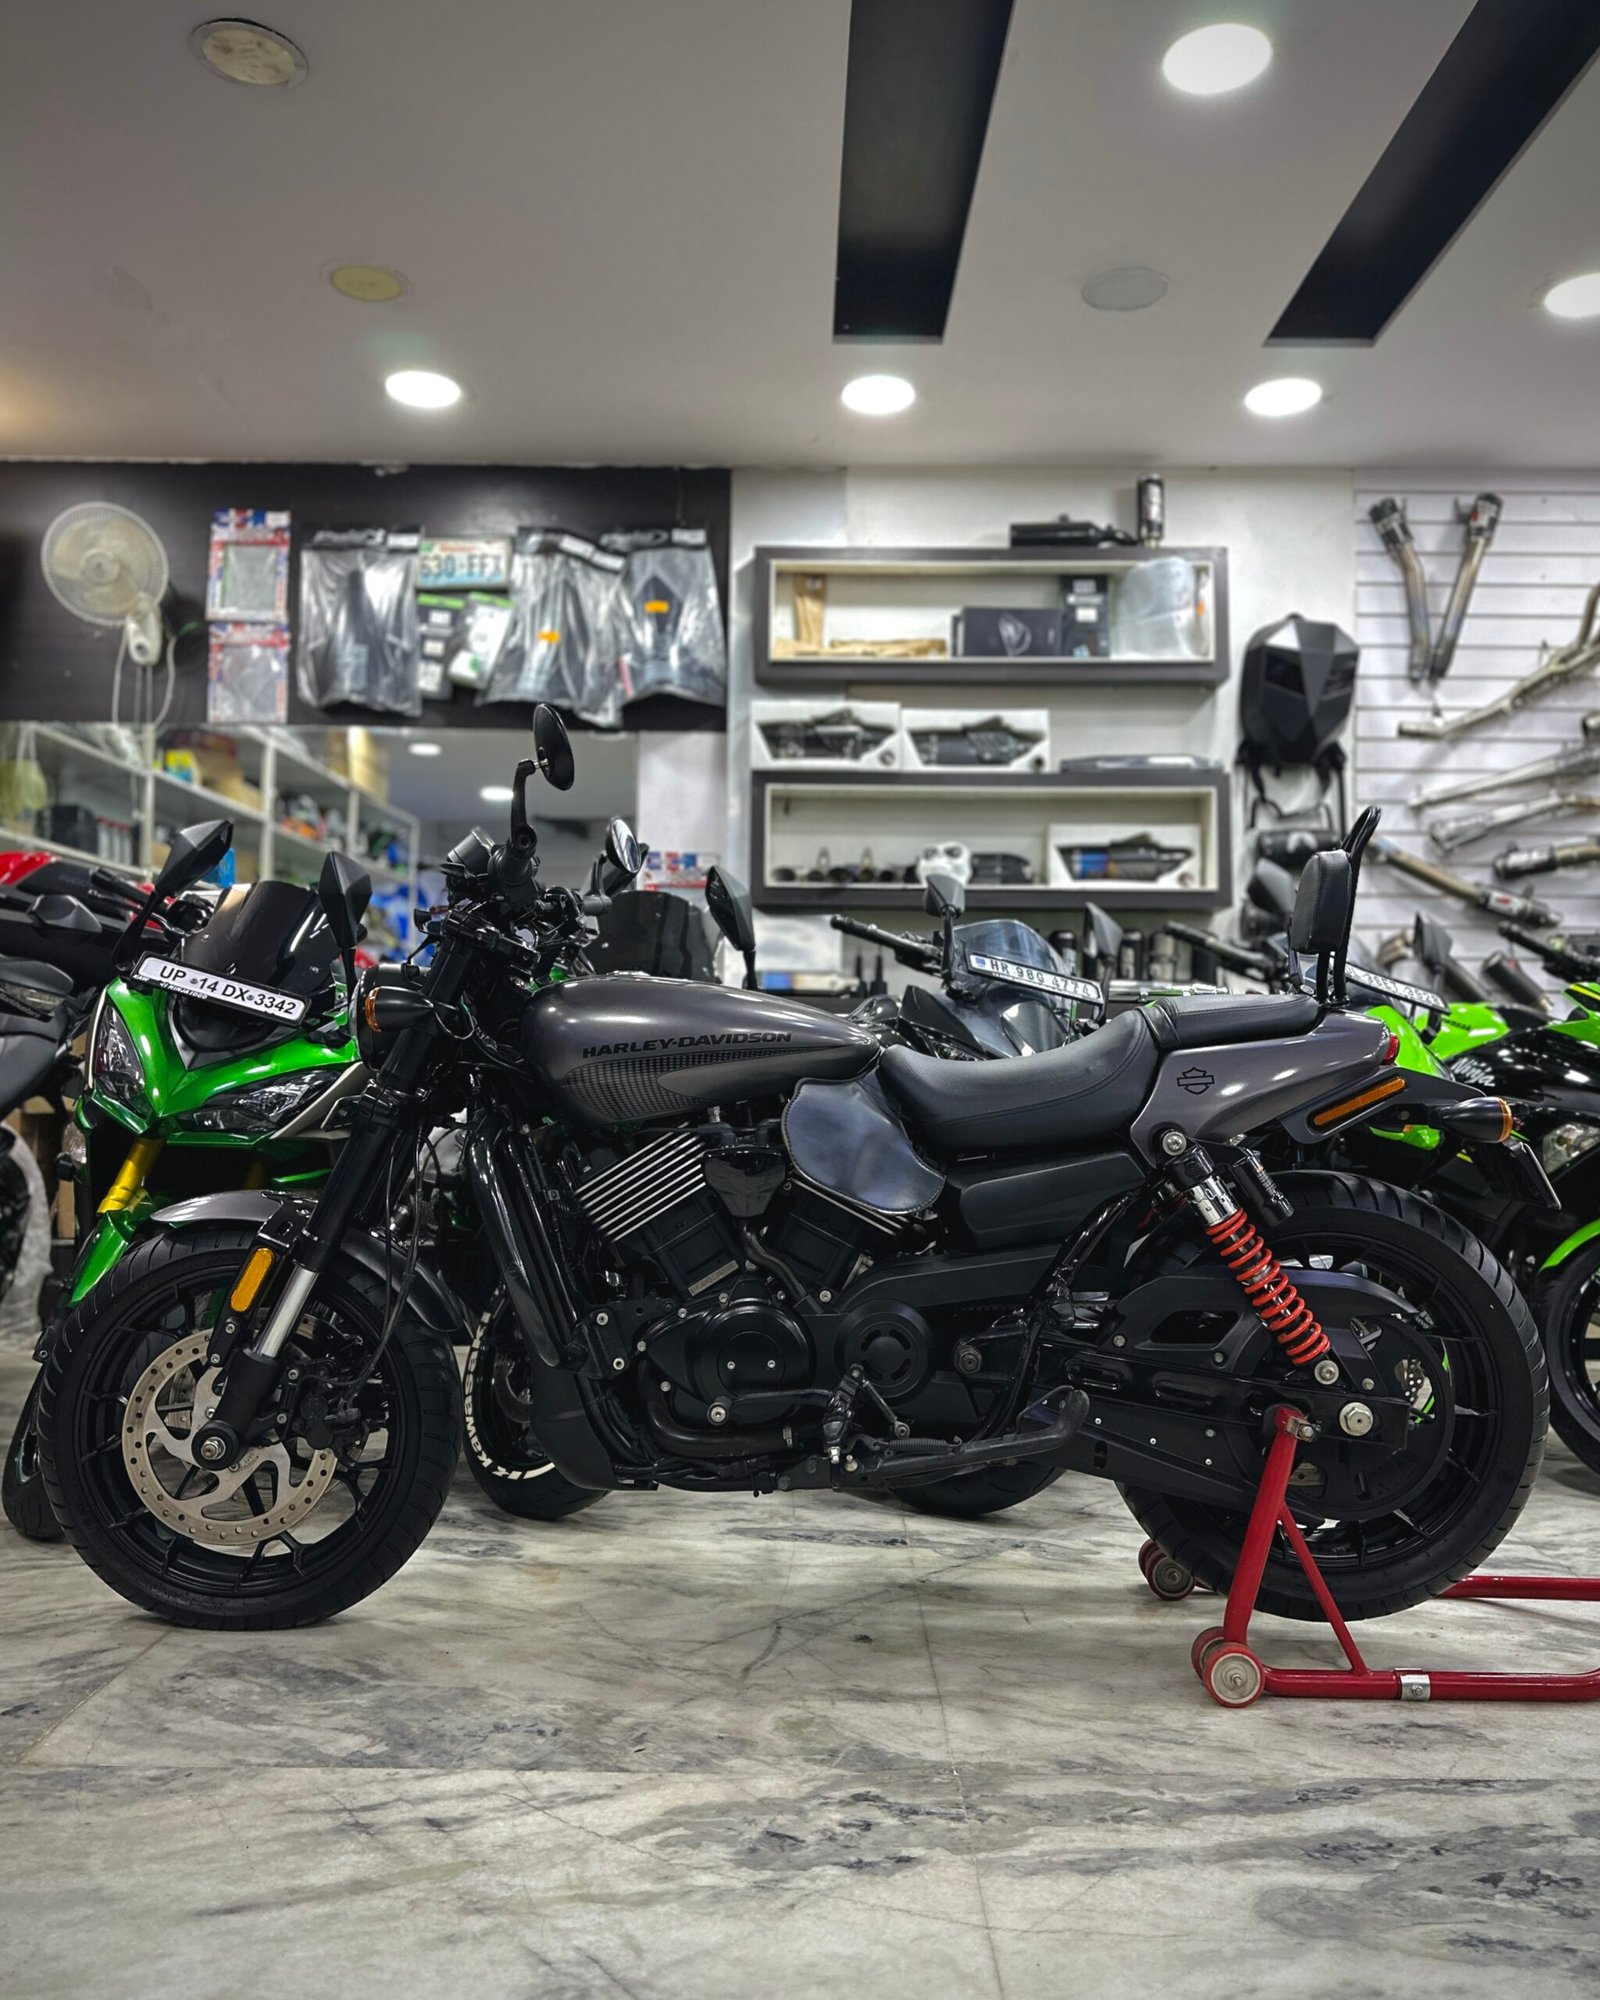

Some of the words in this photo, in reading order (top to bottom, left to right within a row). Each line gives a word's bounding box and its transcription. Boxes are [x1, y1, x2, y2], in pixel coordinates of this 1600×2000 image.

[990, 960, 1009, 974] HR
[159, 965, 187, 983] UP
[199, 977, 219, 993] 14
[222, 984, 251, 1002] DX
[254, 993, 297, 1015] 3342
[582, 1032, 792, 1059] HARLEY-DAVIDSON
[1451, 1057, 1496, 1087] Ninja
[464, 1311, 493, 1469] Kawasaki
